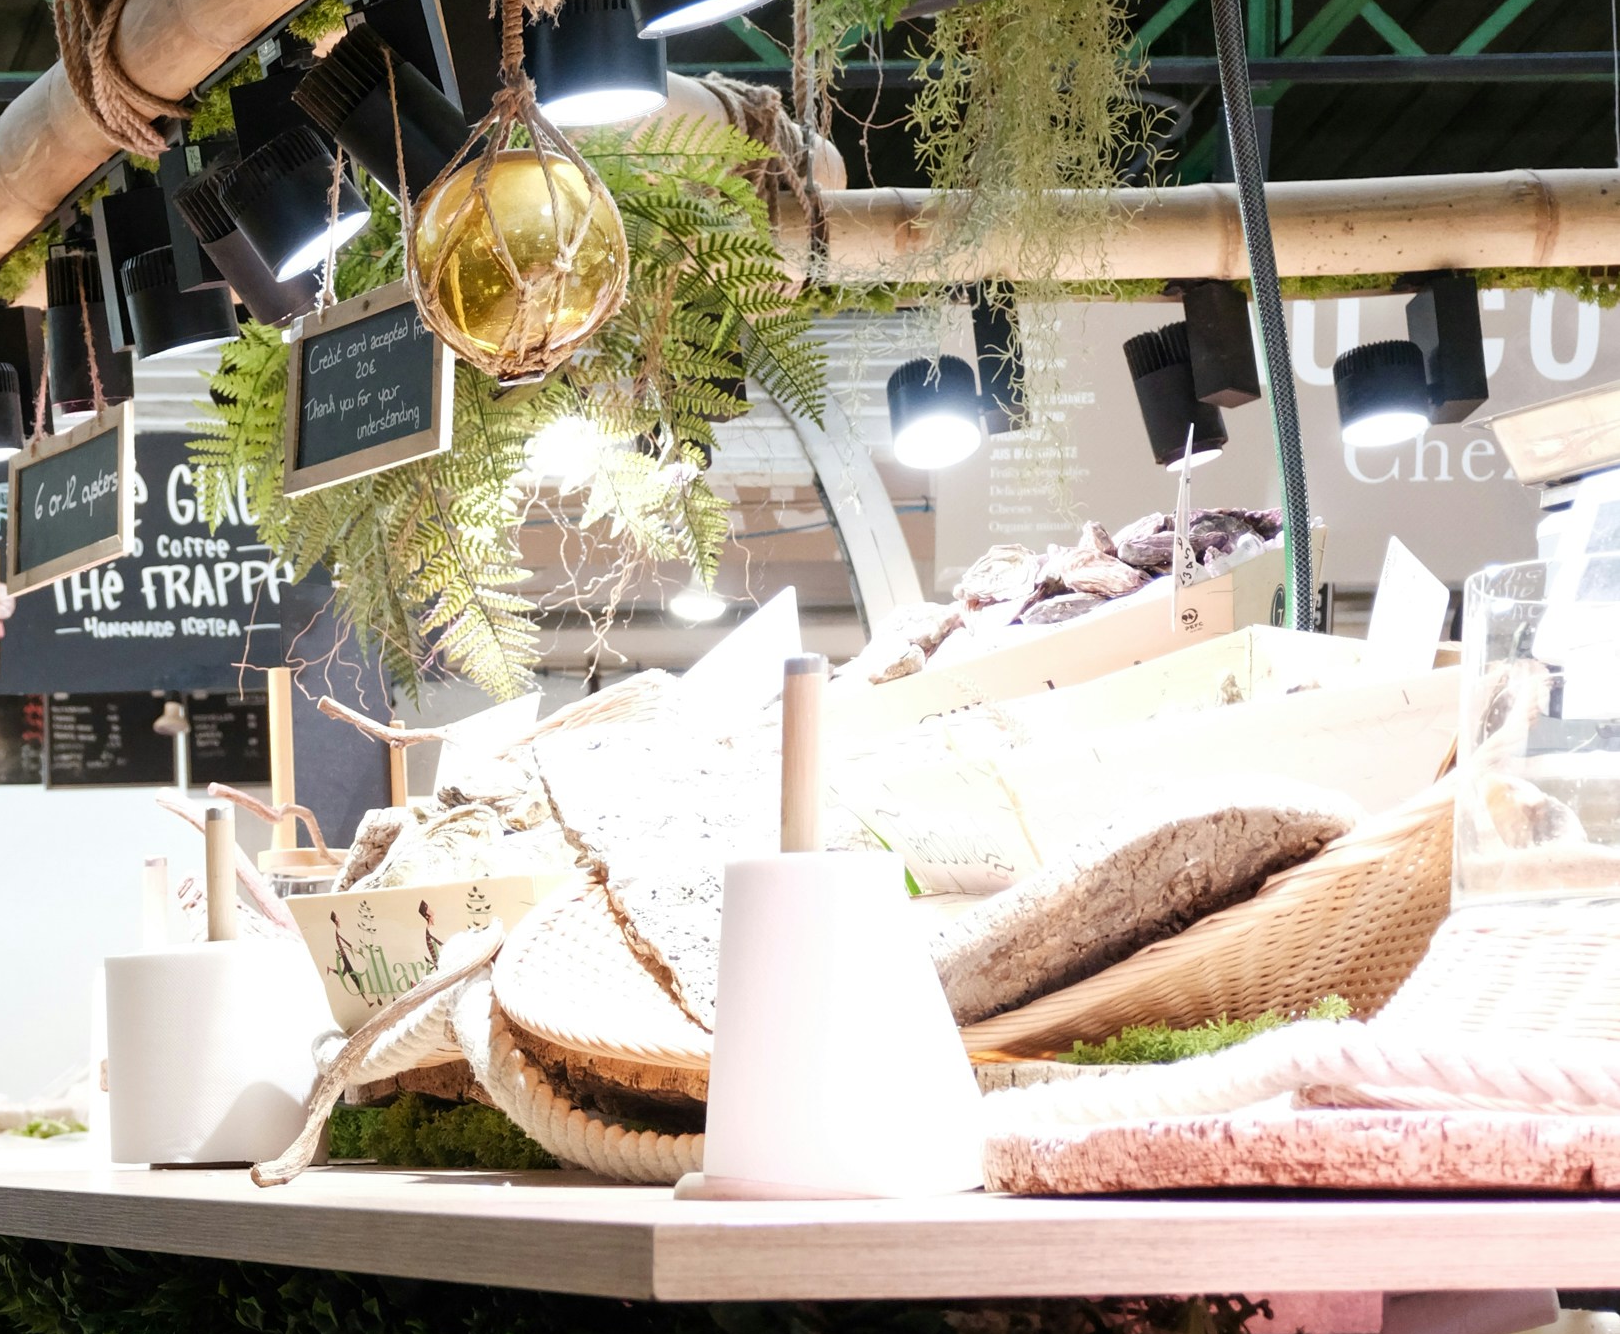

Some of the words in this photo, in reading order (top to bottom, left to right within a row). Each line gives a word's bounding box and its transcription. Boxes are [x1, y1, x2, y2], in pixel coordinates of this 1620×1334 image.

[309, 342, 343, 375] Credit
[346, 333, 367, 359] card
[370, 317, 409, 353] accepted
[413, 315, 433, 341] fro
[355, 359, 377, 380] 20€
[305, 393, 336, 422] Thank
[339, 397, 355, 421] you
[377, 384, 401, 410] your
[356, 400, 421, 440] understanding
[34, 482, 44, 520] 6
[48, 493, 62, 517] or
[81, 468, 119, 517] oysters
[166, 462, 265, 527] GLAC
